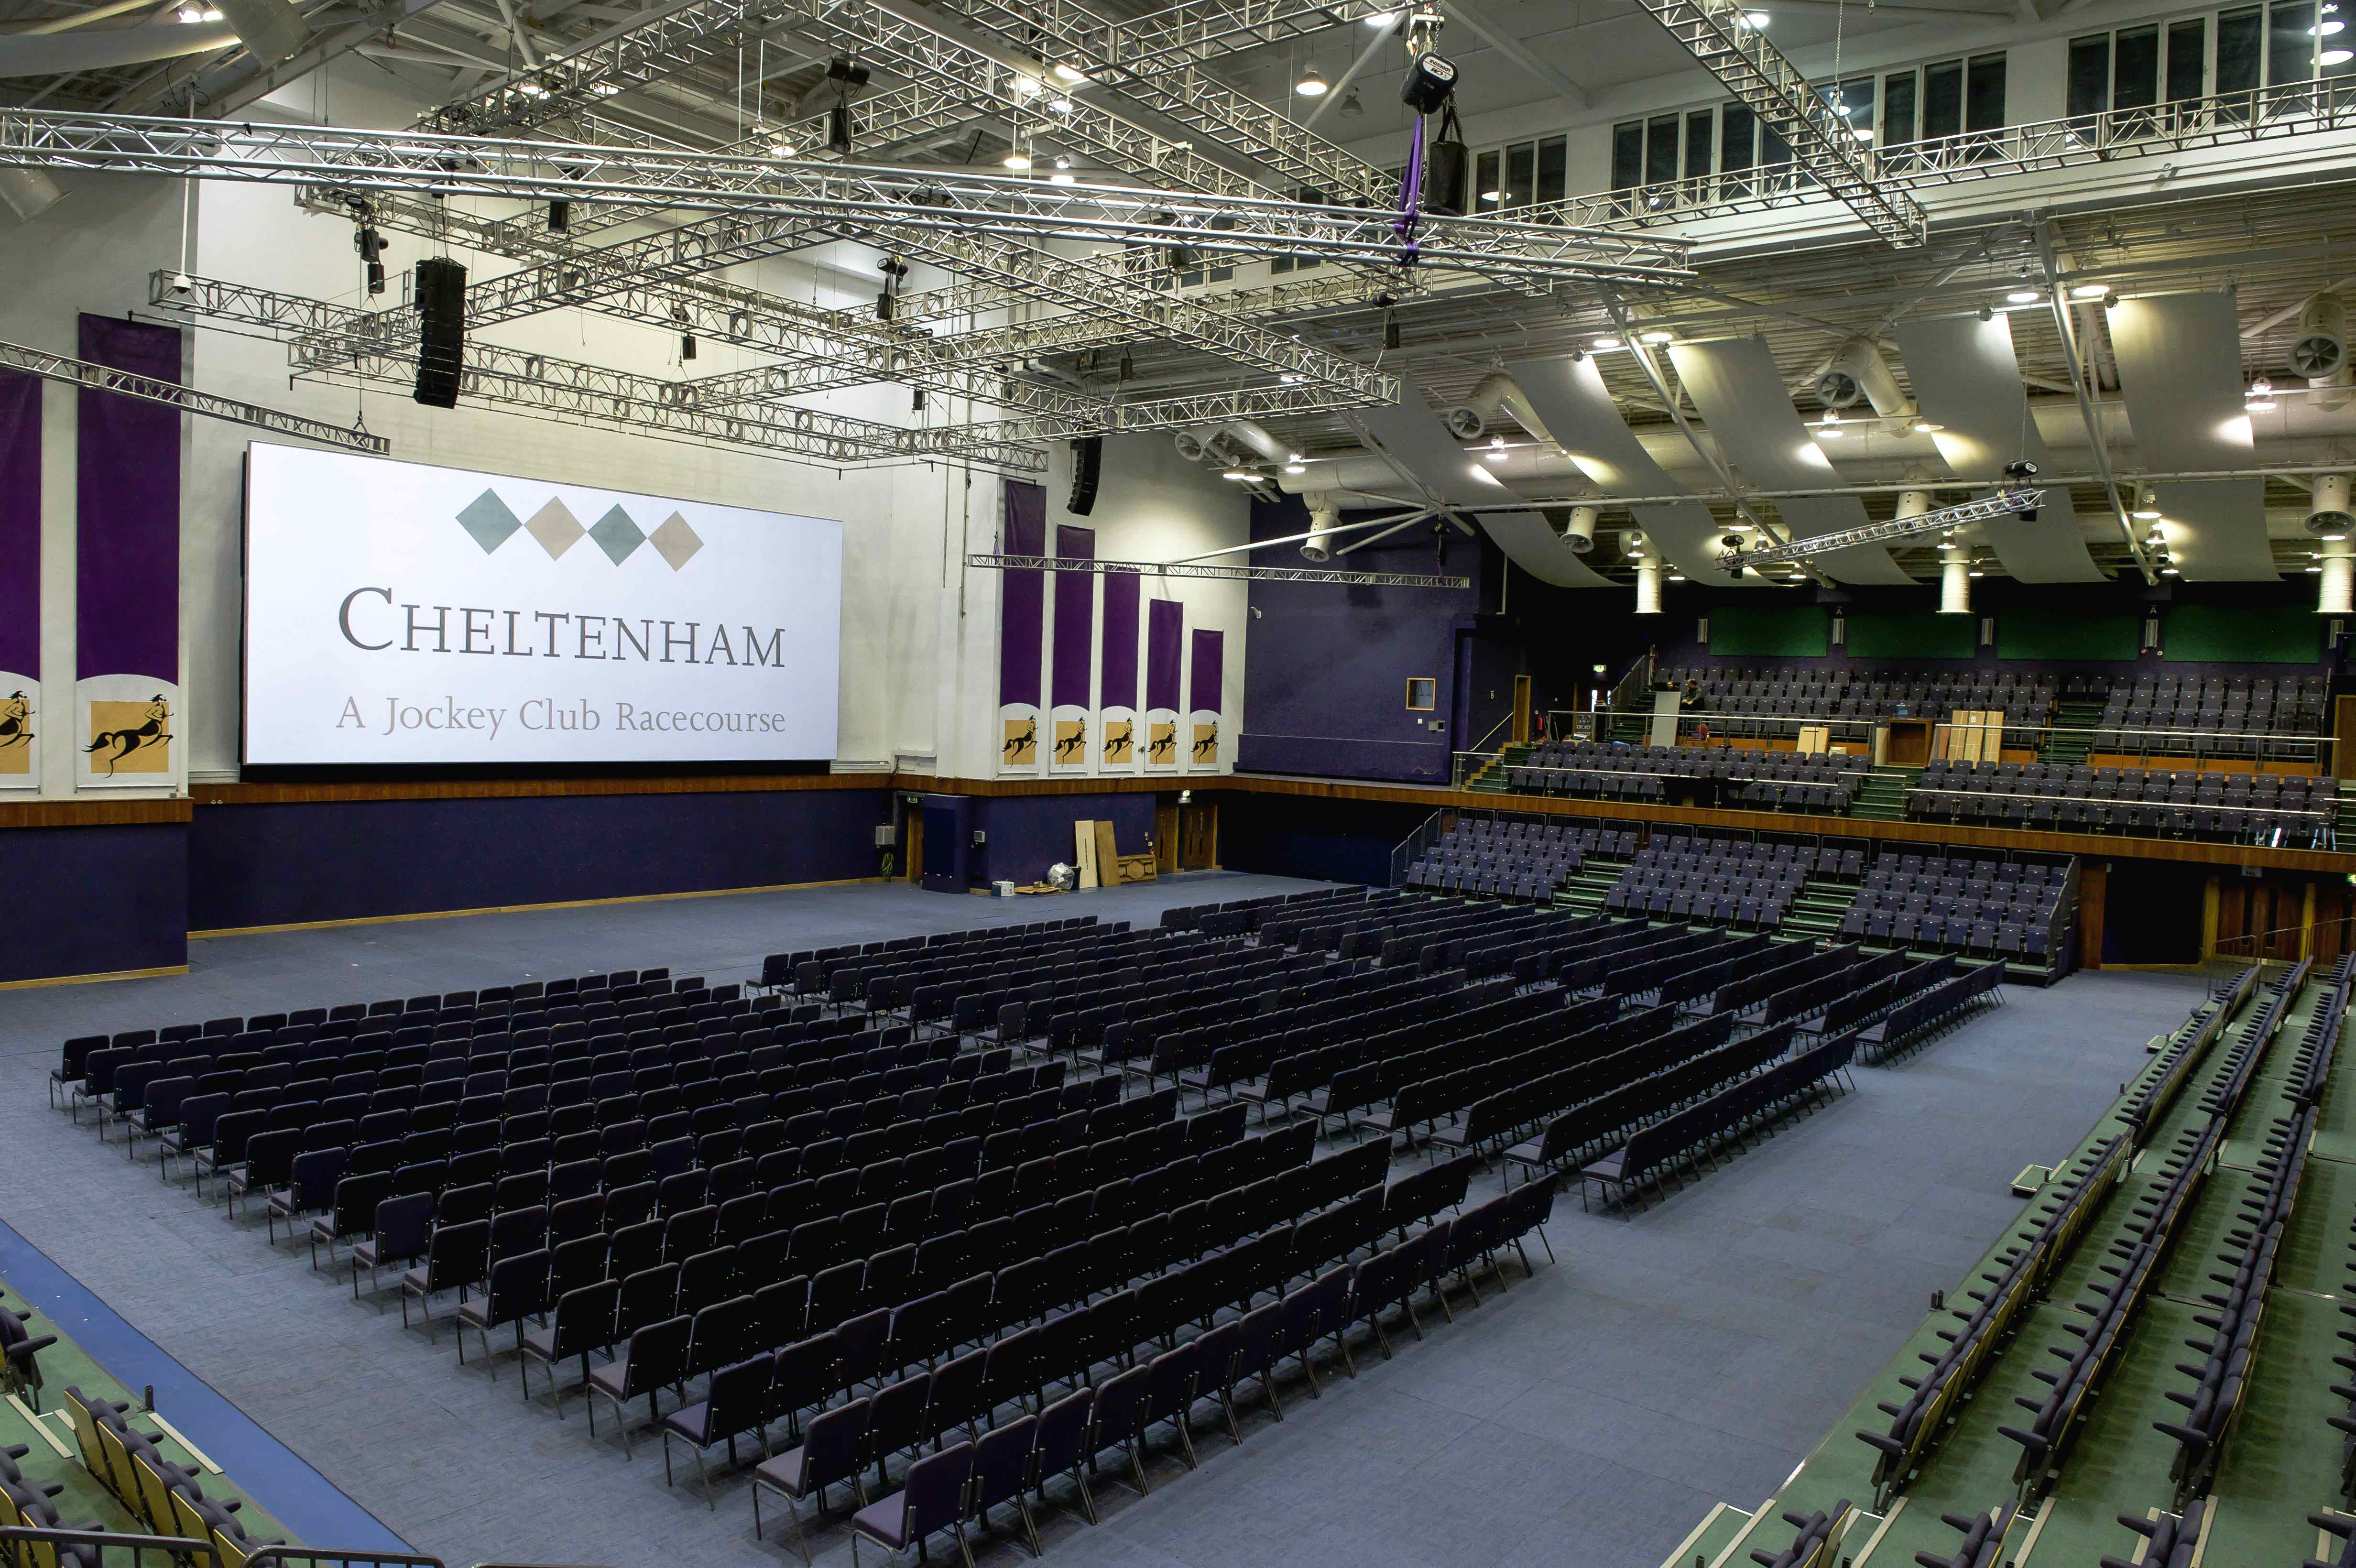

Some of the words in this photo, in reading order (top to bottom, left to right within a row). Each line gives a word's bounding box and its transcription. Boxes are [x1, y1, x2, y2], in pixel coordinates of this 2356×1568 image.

[338, 587, 785, 668] CHELTENHAM
[336, 696, 366, 728] A
[382, 697, 507, 741] Jockey
[520, 698, 600, 730] Club
[615, 702, 787, 733] Racecourse
